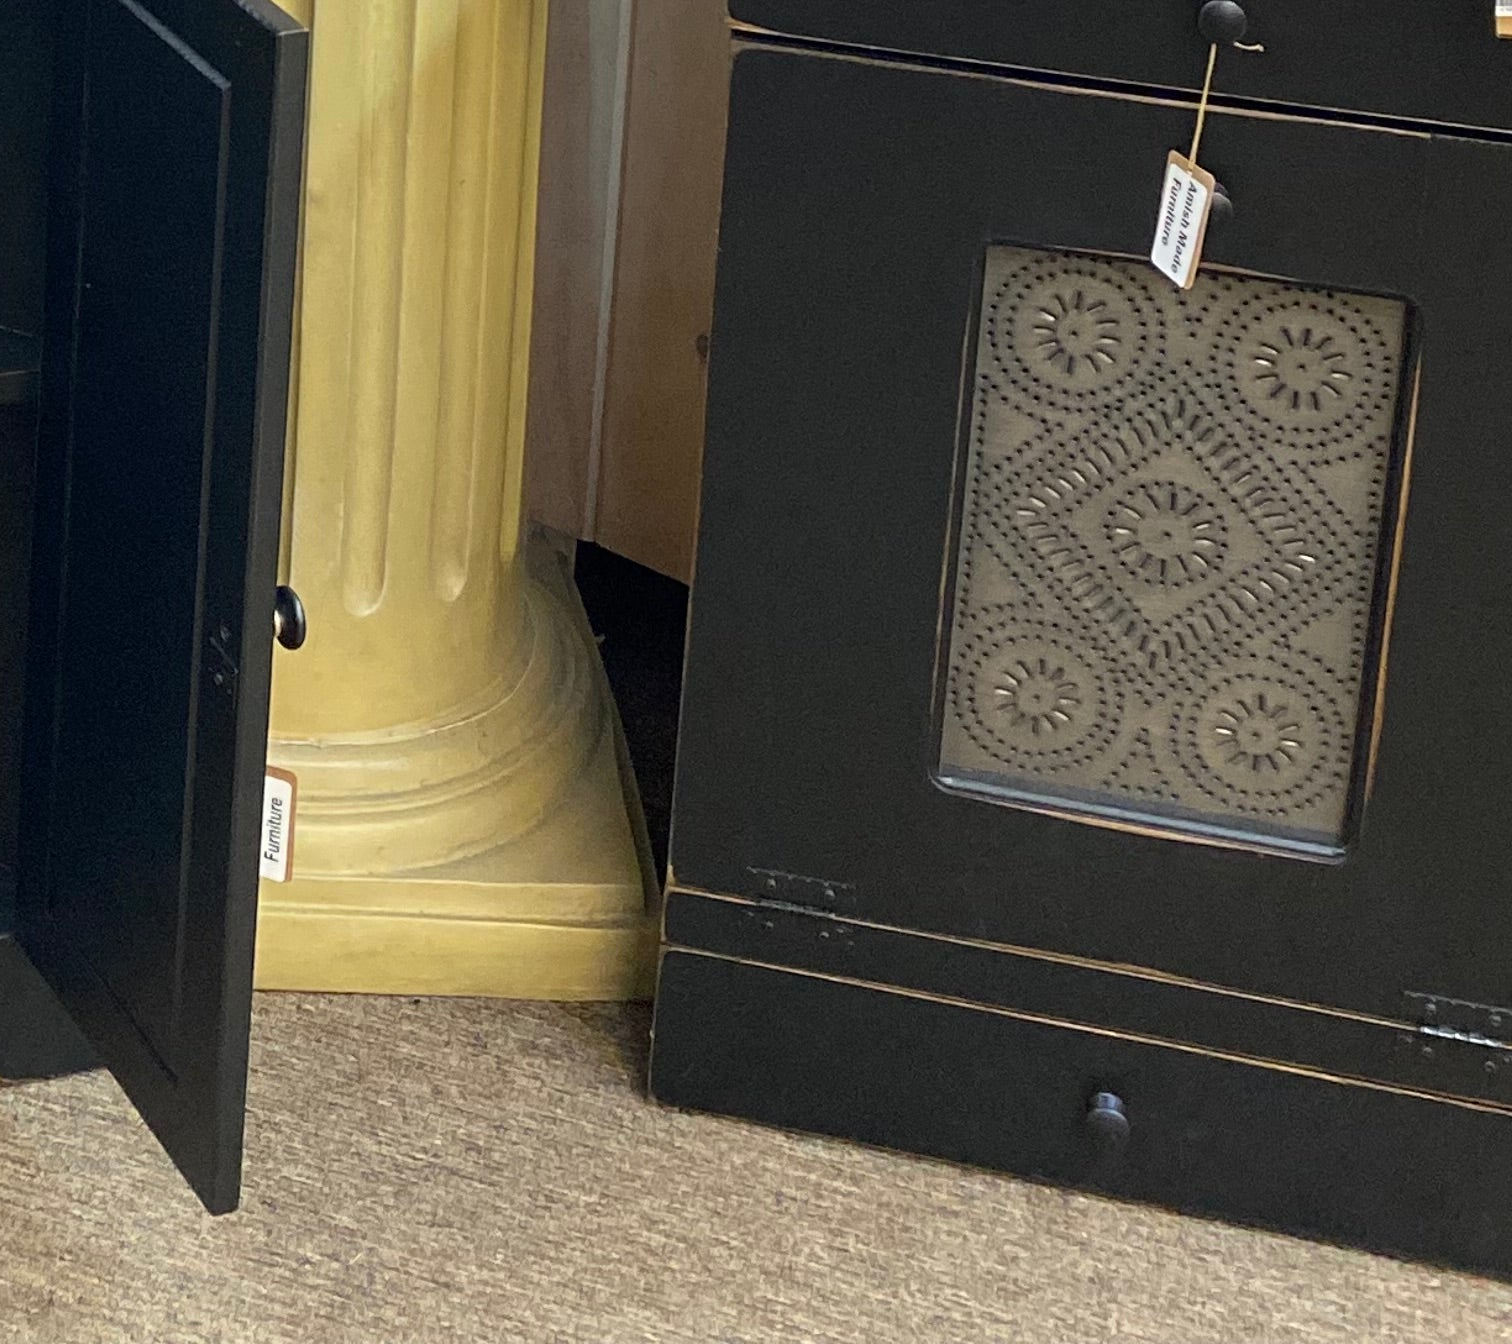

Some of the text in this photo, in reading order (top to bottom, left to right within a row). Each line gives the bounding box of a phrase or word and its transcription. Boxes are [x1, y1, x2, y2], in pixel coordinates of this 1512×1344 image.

[1161, 176, 1183, 248] Furniture
[1171, 180, 1199, 274] Amish Made
[264, 797, 283, 863] Furniture
